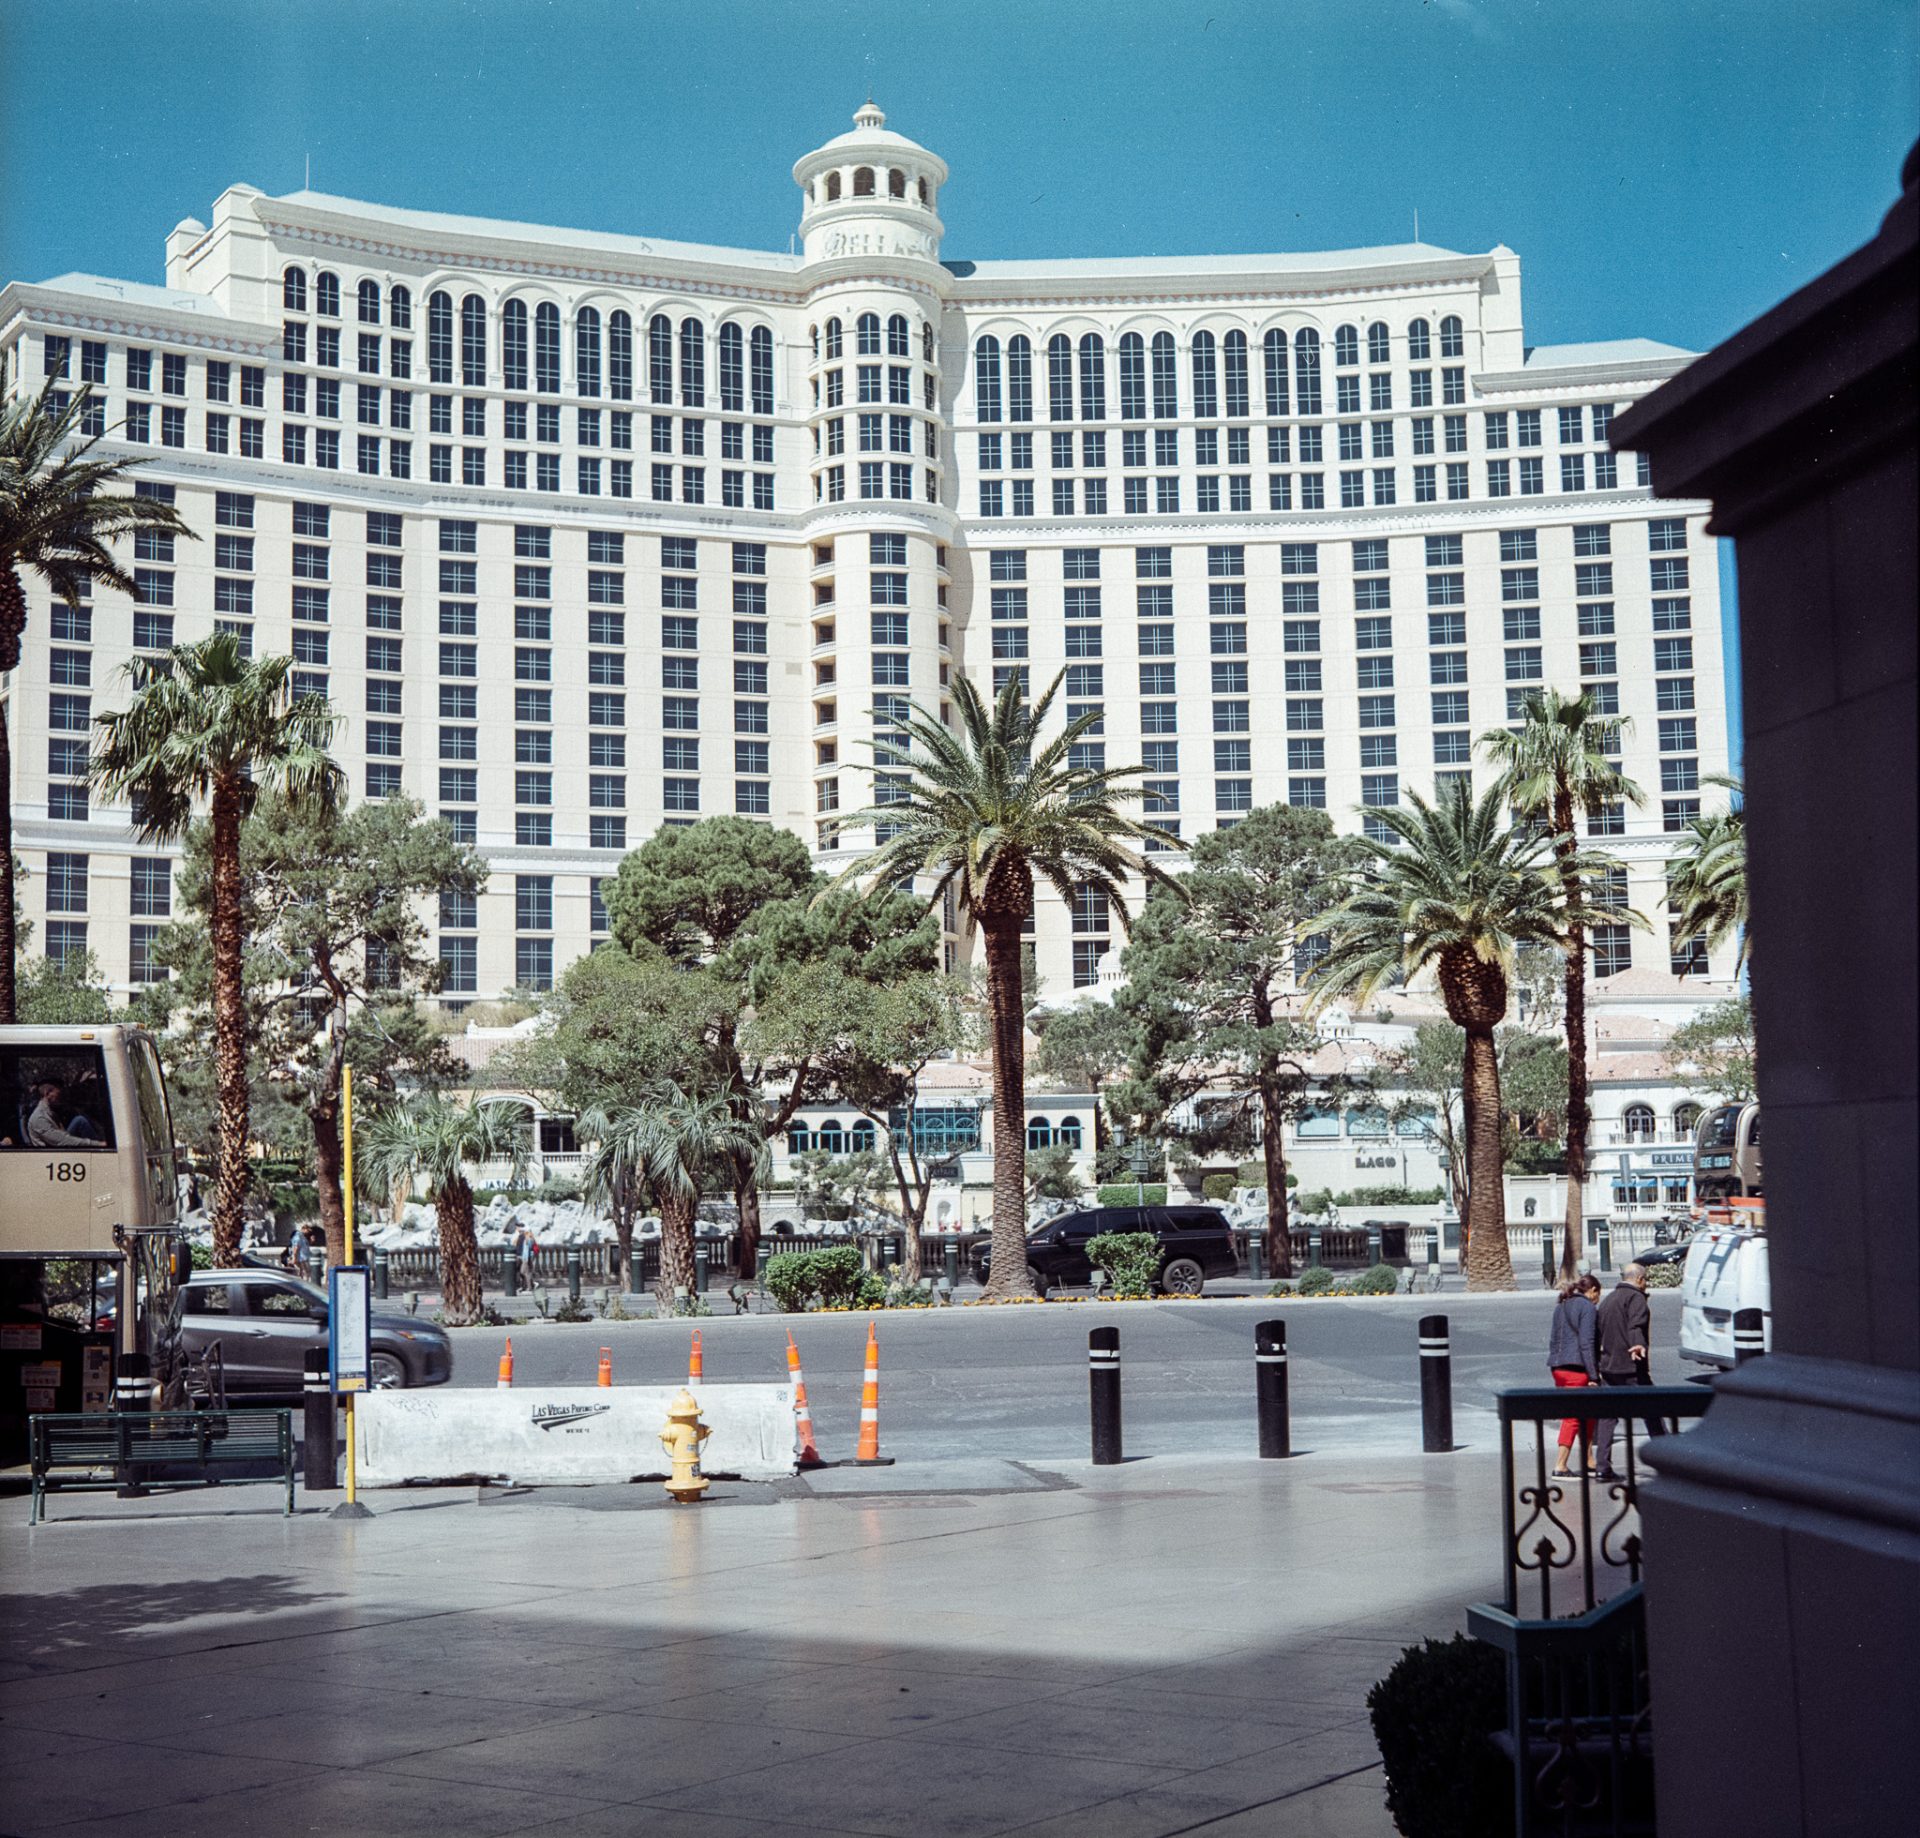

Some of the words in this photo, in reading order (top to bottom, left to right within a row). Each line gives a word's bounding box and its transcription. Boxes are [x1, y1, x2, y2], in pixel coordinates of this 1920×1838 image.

[1355, 1156, 1396, 1168] LAGO
[1653, 1154, 1692, 1165] PRIME
[46, 1162, 86, 1182] 189
